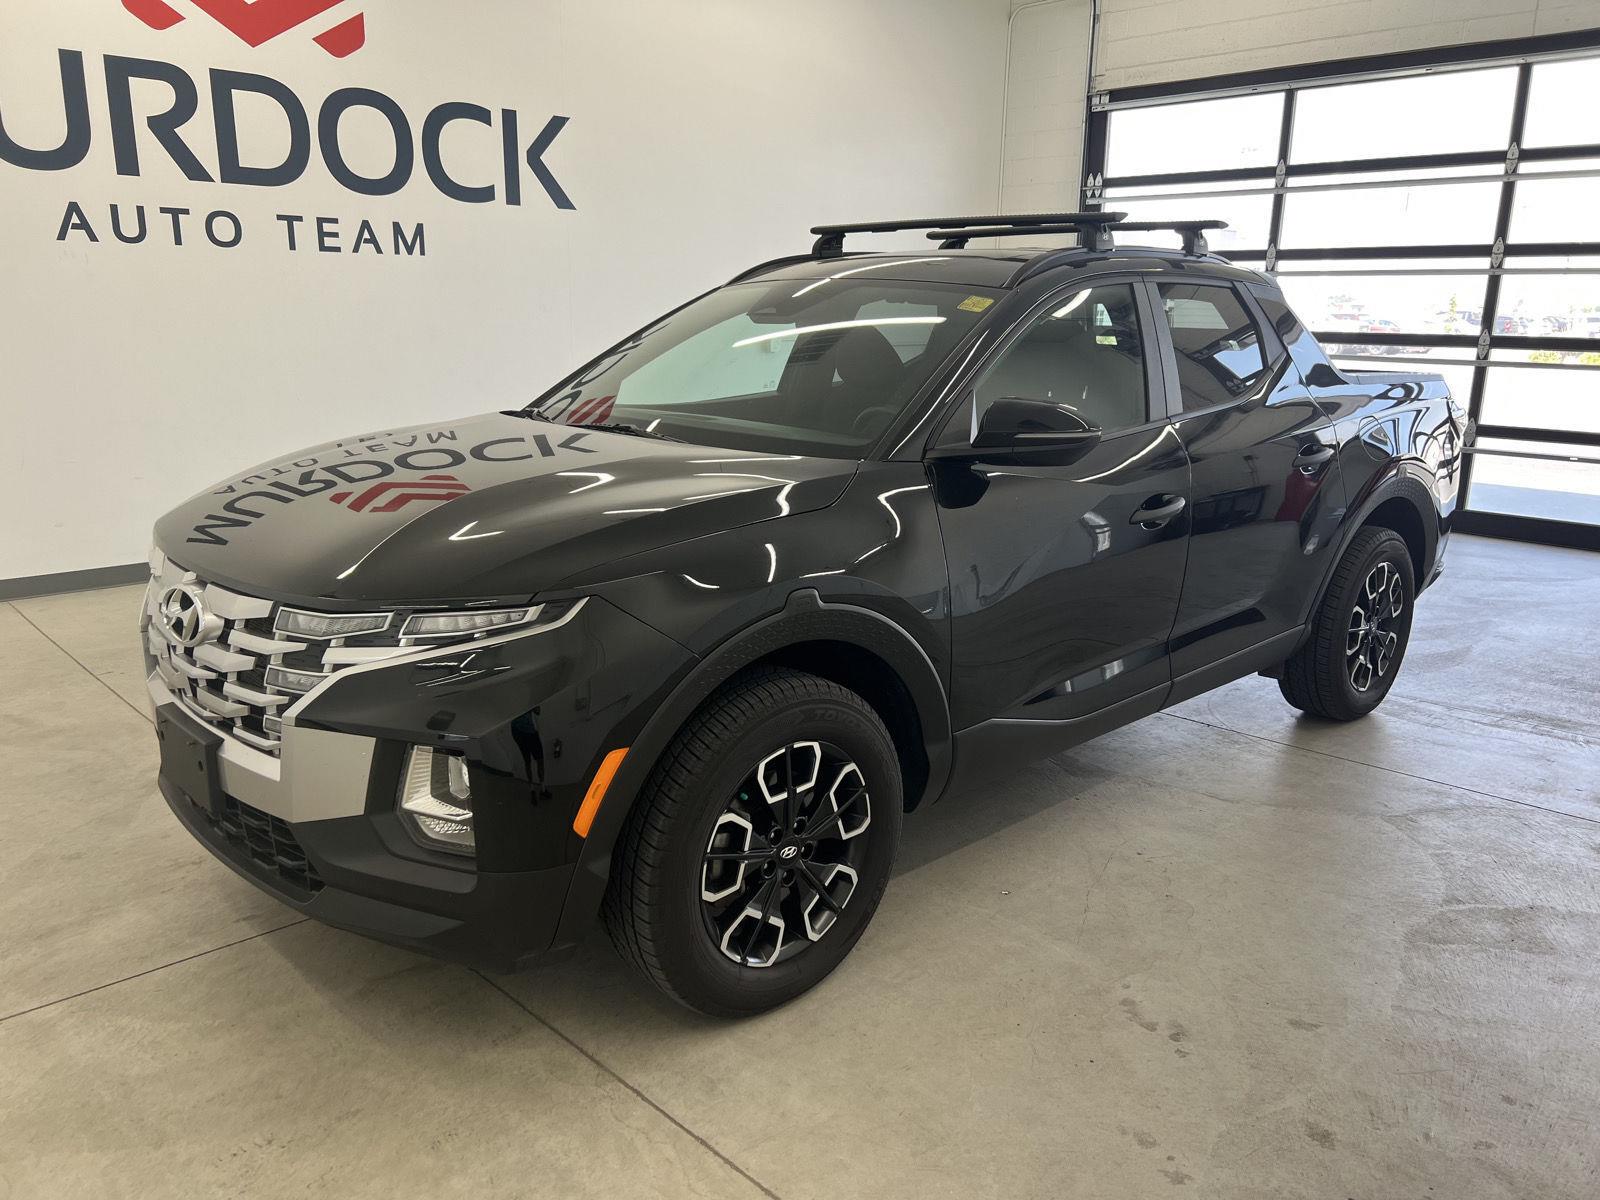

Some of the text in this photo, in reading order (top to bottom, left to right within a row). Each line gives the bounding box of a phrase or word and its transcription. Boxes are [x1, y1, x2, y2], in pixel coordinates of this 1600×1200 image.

[0, 48, 577, 210] URDOCK
[56, 201, 427, 257] AUTO TEAM
